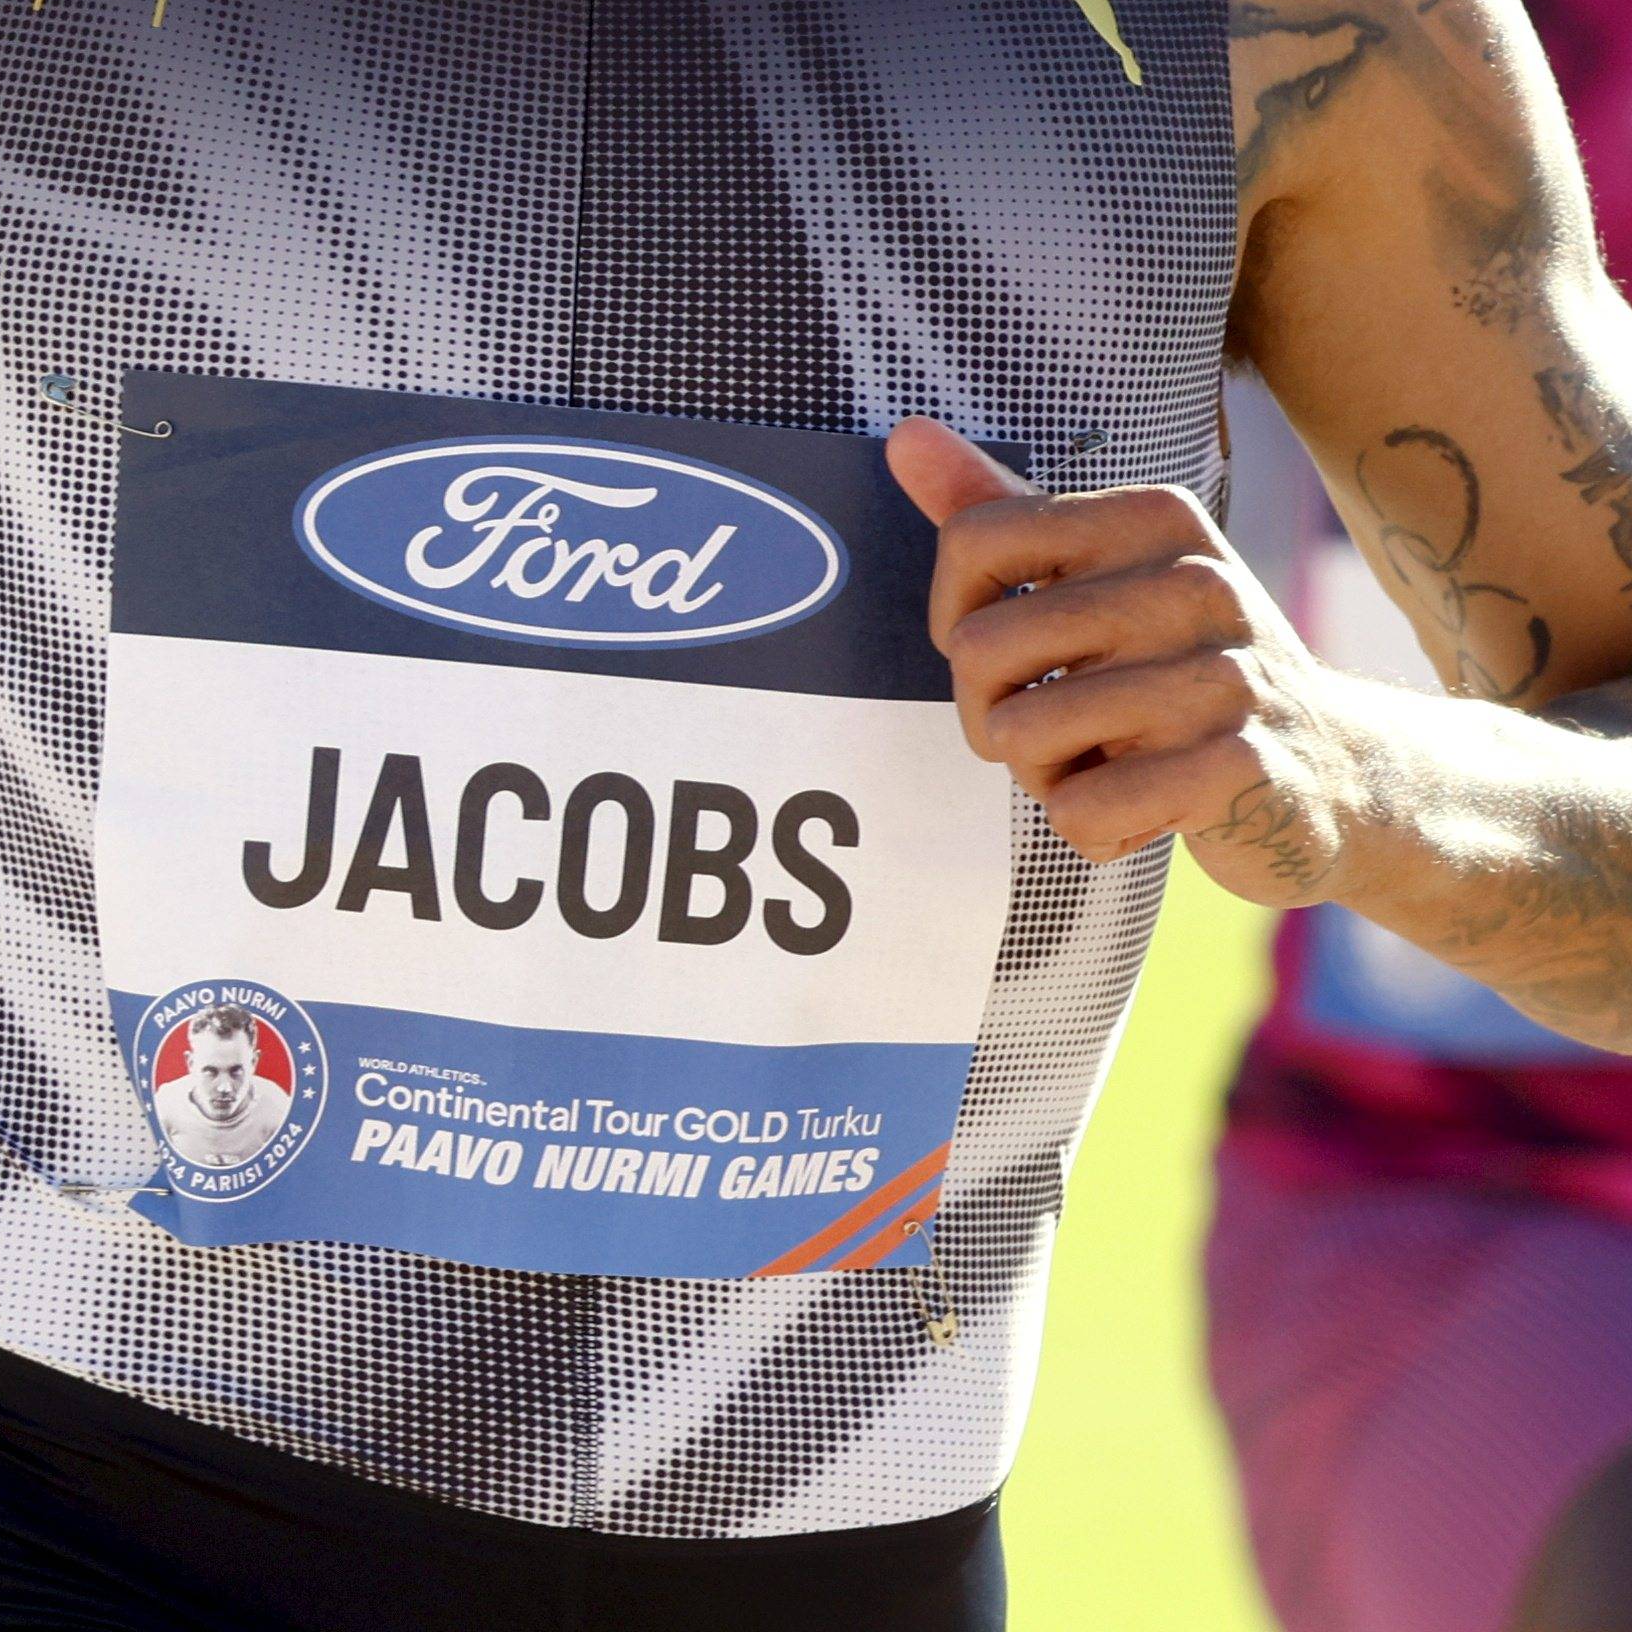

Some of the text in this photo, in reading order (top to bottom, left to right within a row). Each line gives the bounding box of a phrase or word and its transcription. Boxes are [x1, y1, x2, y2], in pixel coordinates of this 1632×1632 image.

[405, 466, 737, 615] Ford
[241, 746, 861, 956] JACOBS
[153, 986, 288, 1029] PAAVO NURMI
[358, 1057, 408, 1074] WORLD
[354, 1072, 883, 1144] Continental Tour GOLD Turku
[190, 1162, 264, 1192] PARIISI
[264, 1121, 304, 1169] 2024
[350, 1118, 881, 1201] PAAVO NURMI GAMES
